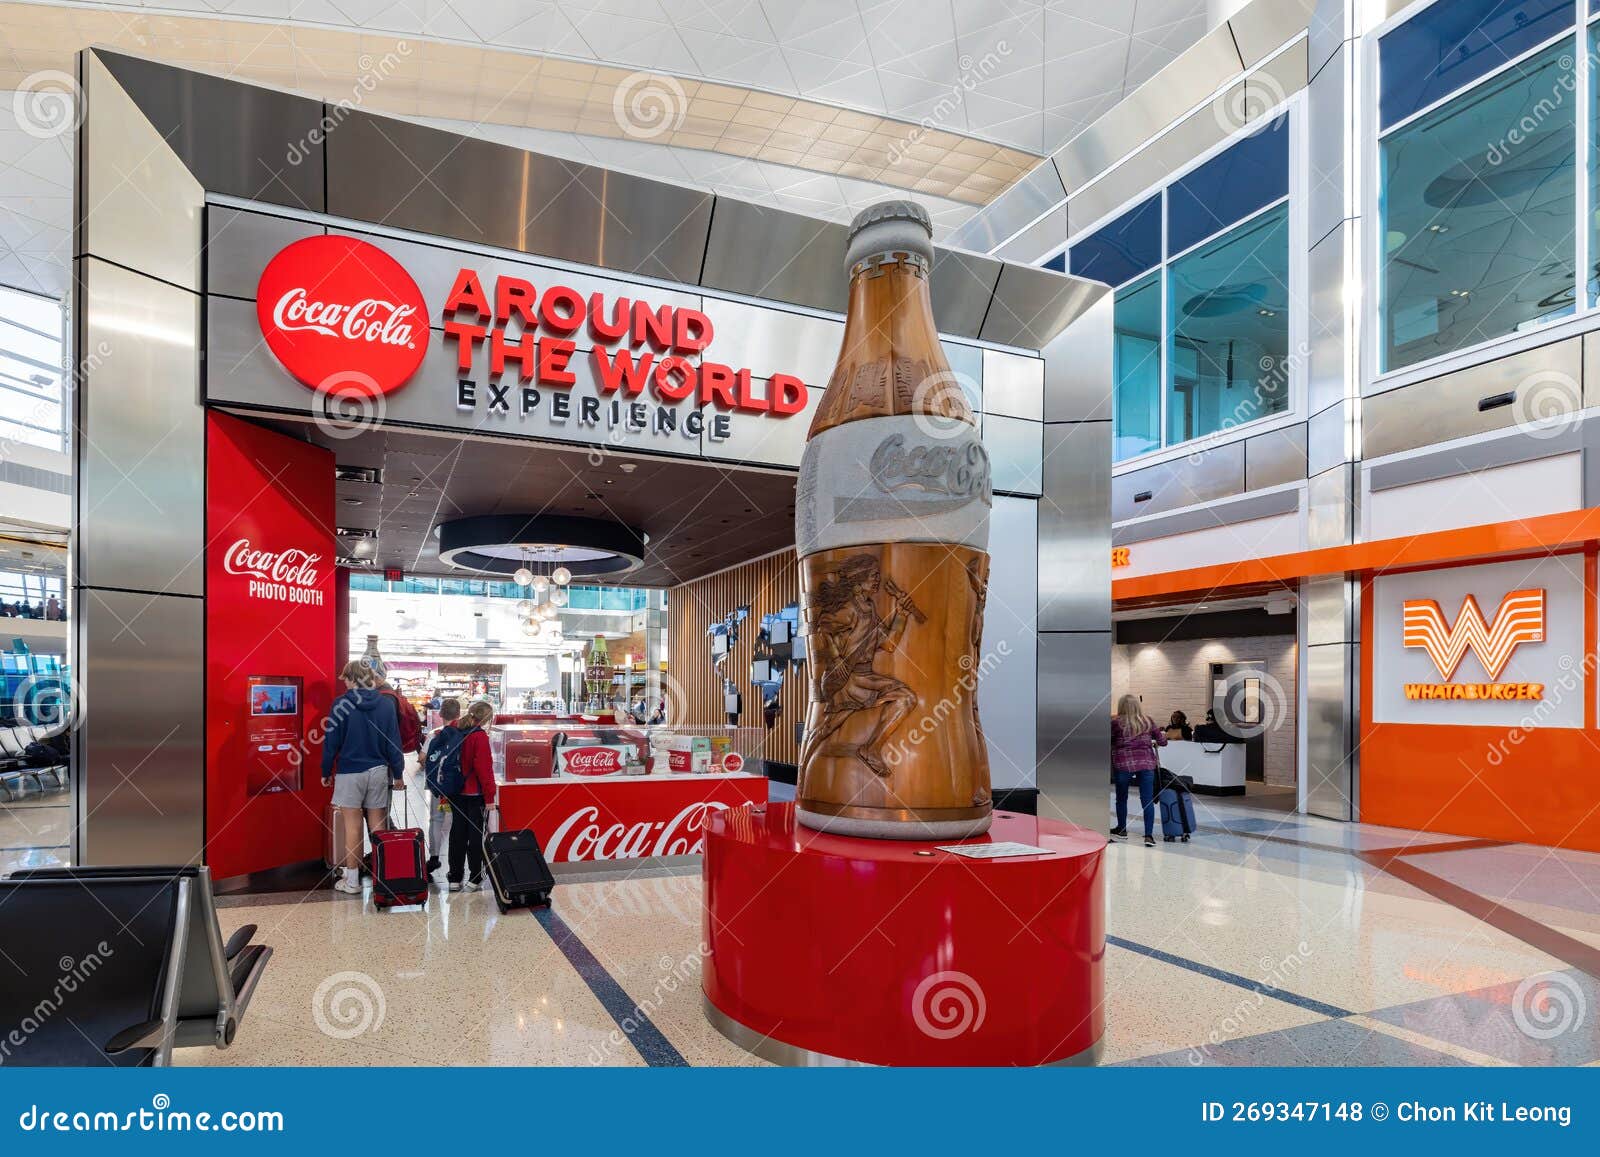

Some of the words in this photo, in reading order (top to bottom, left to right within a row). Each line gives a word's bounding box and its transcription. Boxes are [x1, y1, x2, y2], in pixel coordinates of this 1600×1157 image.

[273, 287, 417, 347] Coca-Cola
[443, 268, 714, 353] AROUND
[443, 320, 577, 388] THE
[591, 345, 809, 418] WORLD
[456, 379, 731, 442] EXPERIENCE
[224, 538, 322, 586] Coca-Cola
[249, 580, 287, 601] PHOTO
[289, 586, 323, 606] BOOTH
[1404, 682, 1545, 700] WHATABURGER
[570, 751, 615, 769] Coca-Cola
